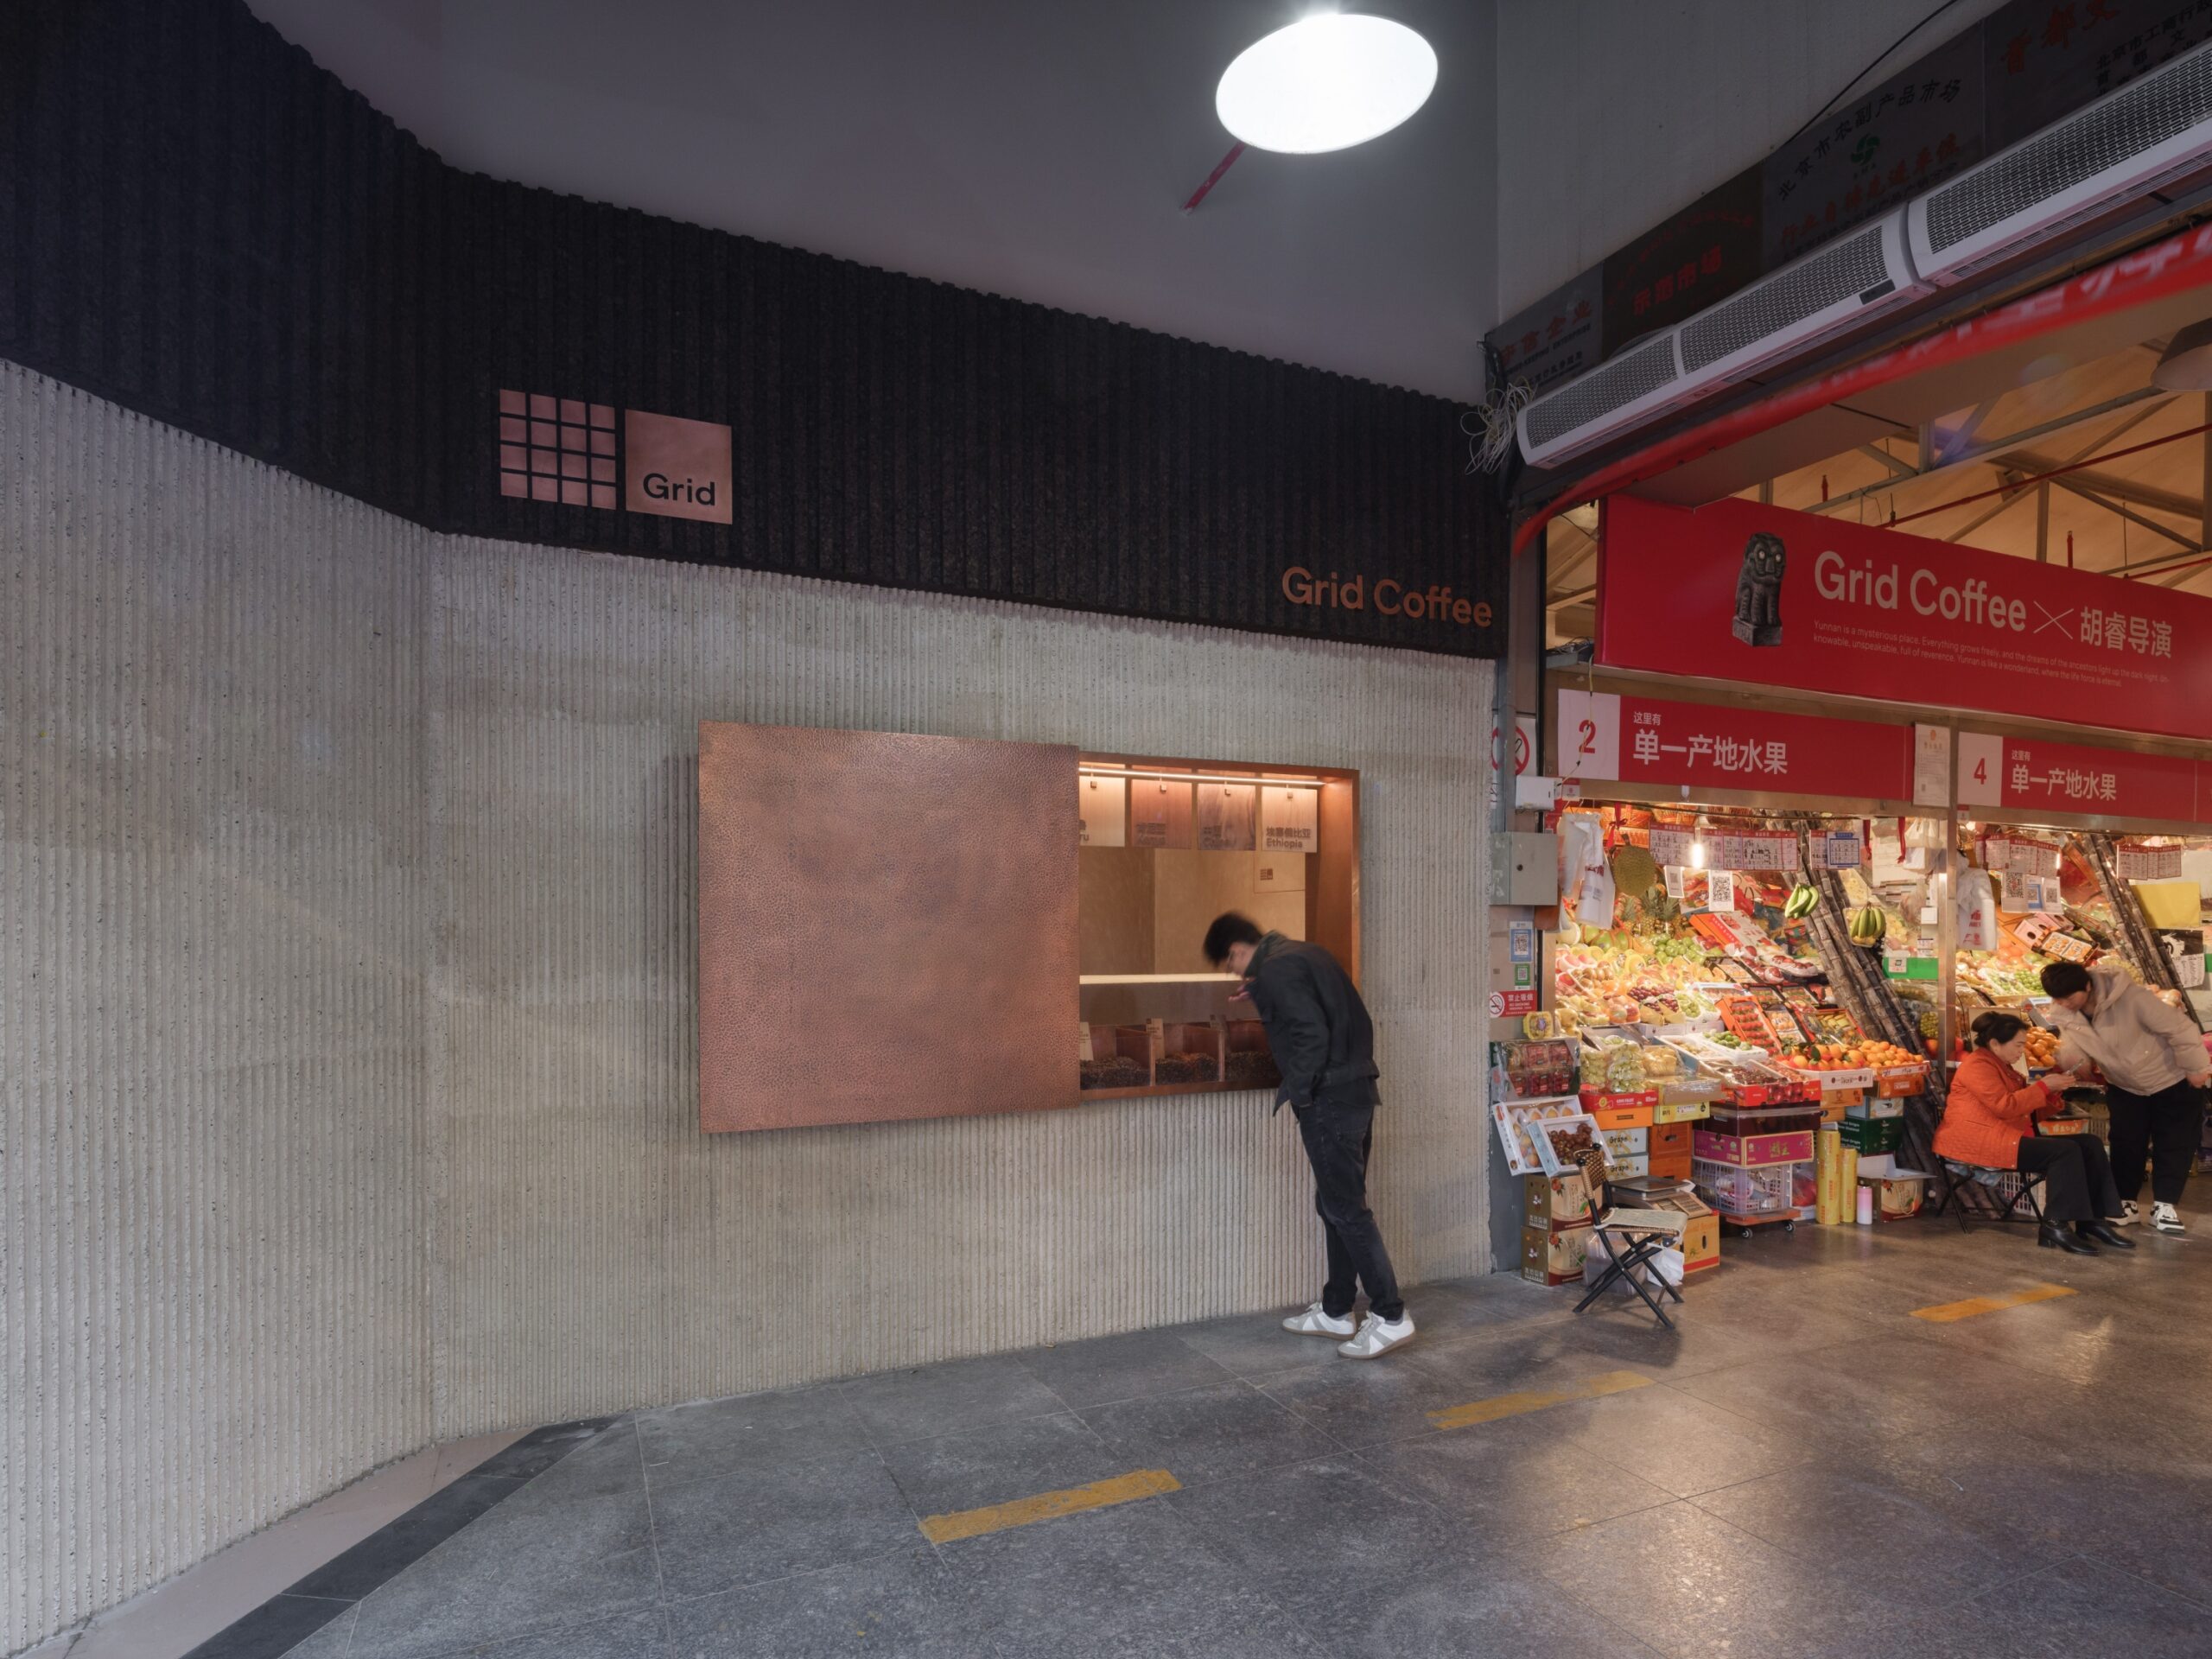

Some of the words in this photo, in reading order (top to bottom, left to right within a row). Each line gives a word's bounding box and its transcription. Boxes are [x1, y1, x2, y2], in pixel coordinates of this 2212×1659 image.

[1777, 79, 1961, 200] 北京市农副产品市场
[642, 473, 715, 506] Grid
[1282, 566, 1363, 610] Grid
[1374, 579, 1492, 627] Coffee
[1815, 550, 1899, 610] Grid
[1910, 569, 2026, 632] Coffee
[2080, 606, 2172, 658] 胡睿导演
[1814, 634, 1851, 647] knowable,
[1853, 640, 1899, 655] unspeakable,
[1901, 645, 1911, 656] full
[1815, 620, 1842, 632] Yunnan
[1858, 628, 1899, 640] mysterious
[1922, 637, 1959, 652] Everything
[1960, 645, 1980, 654] grows
[1633, 710, 1662, 726] 这里有
[1579, 719, 1596, 754] 2
[1633, 728, 1788, 775] 单一产地水果
[1974, 757, 1986, 785] 4
[2011, 749, 2031, 762] 这里有
[2011, 764, 2116, 801] 单一产地水果
[1267, 838, 1303, 849] Ethiopia
